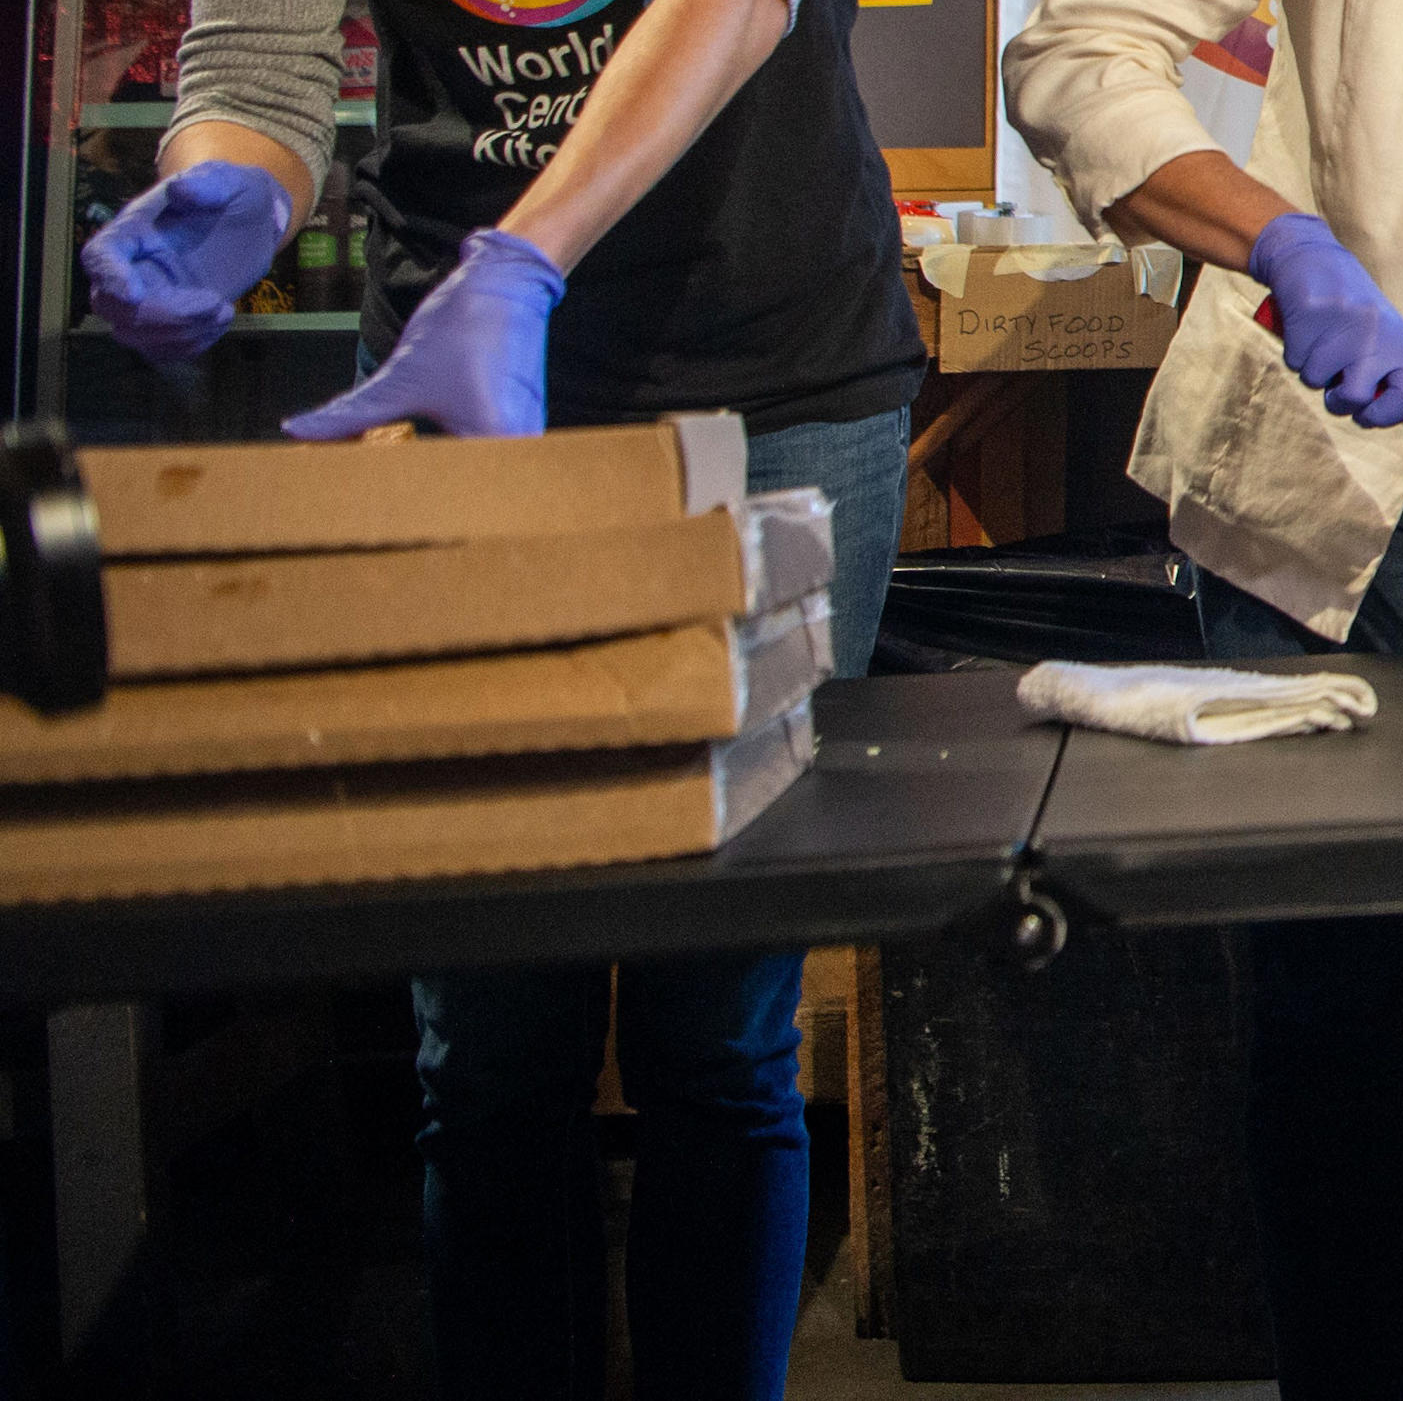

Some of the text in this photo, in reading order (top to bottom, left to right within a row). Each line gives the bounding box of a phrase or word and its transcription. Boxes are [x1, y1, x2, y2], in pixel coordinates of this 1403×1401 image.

[458, 23, 614, 87] World
[958, 310, 1126, 335] DIRTY FOOD
[1021, 341, 1134, 363] SCOOPS
